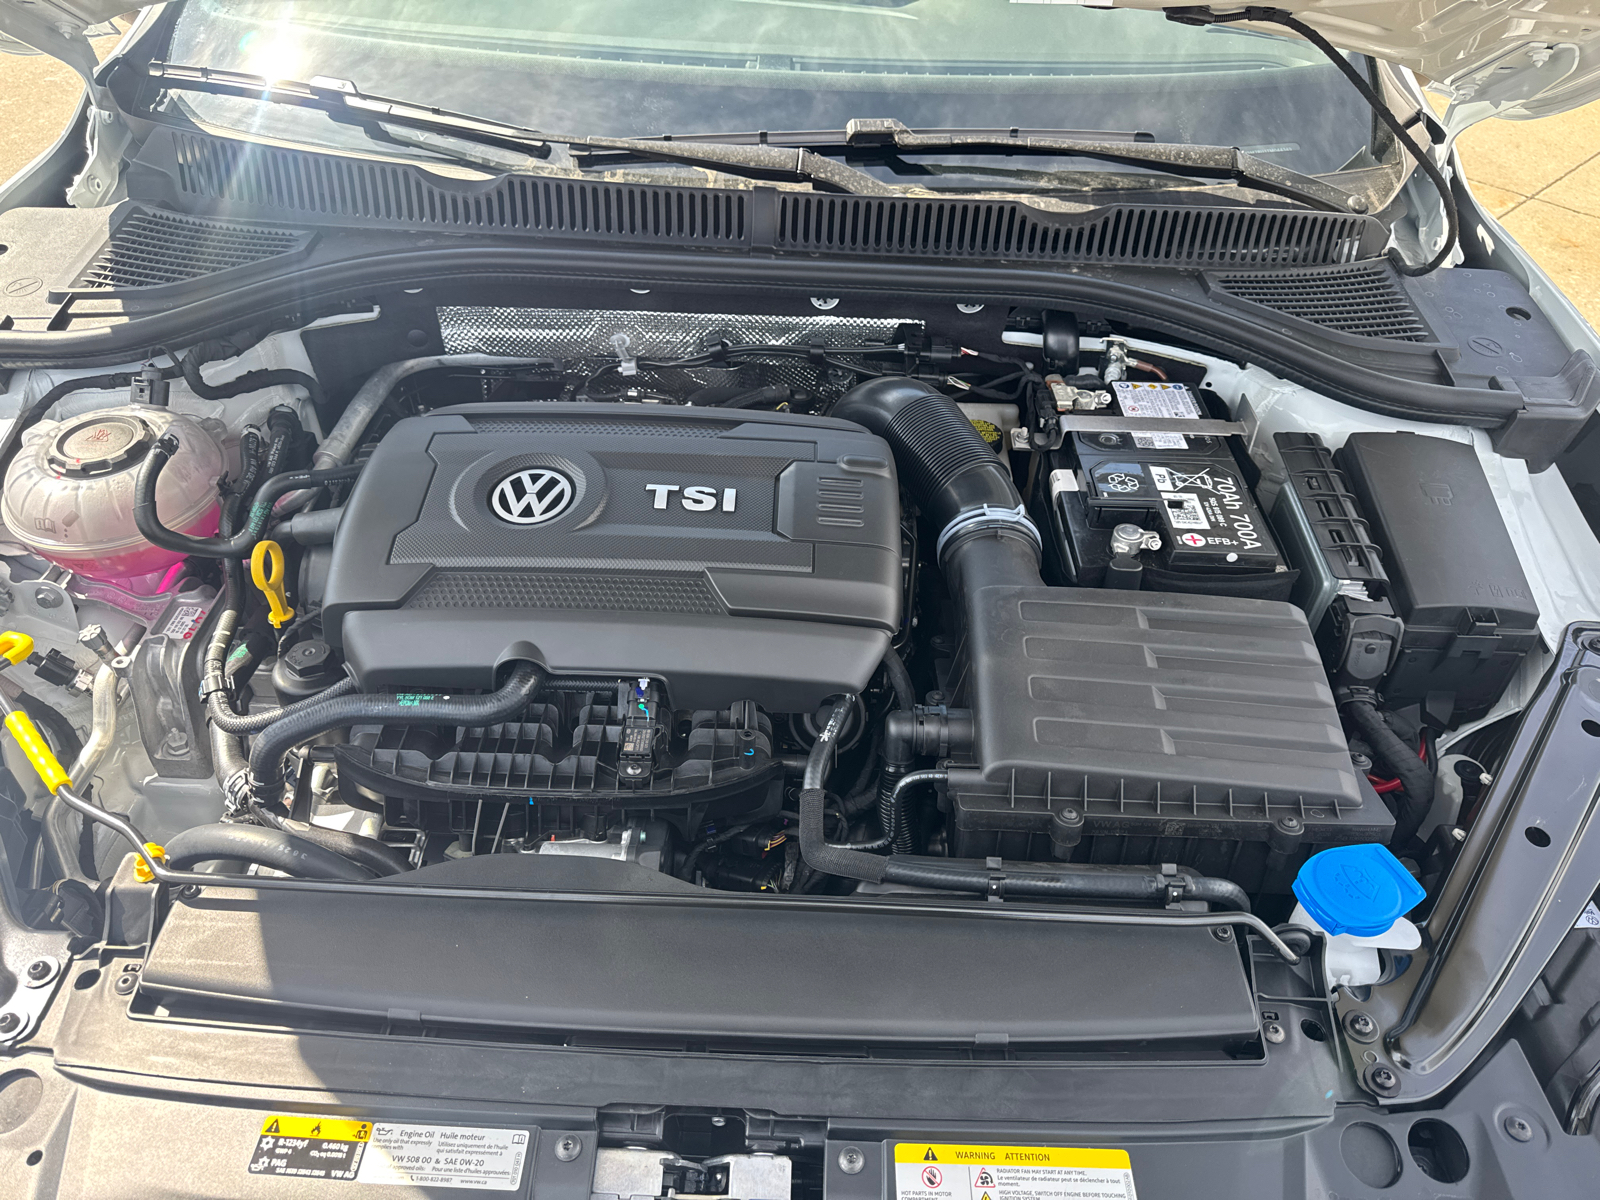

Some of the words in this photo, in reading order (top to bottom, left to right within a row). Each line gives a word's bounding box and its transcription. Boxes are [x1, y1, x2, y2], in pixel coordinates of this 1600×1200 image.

[645, 483, 737, 512] TSI
[1214, 477, 1243, 510] 70Ah
[1230, 514, 1262, 550] 700A
[1207, 537, 1239, 546] EFB+
[400, 1130, 423, 1139] Engine
[440, 1132, 458, 1140] Huile
[955, 1151, 995, 1160] WARNING
[1005, 1152, 1050, 1161] ATTENTION
[271, 1159, 287, 1167] PAG
[406, 1156, 420, 1164] 508
[459, 1158, 484, 1166] 0W-20
[331, 1170, 343, 1178] VW
